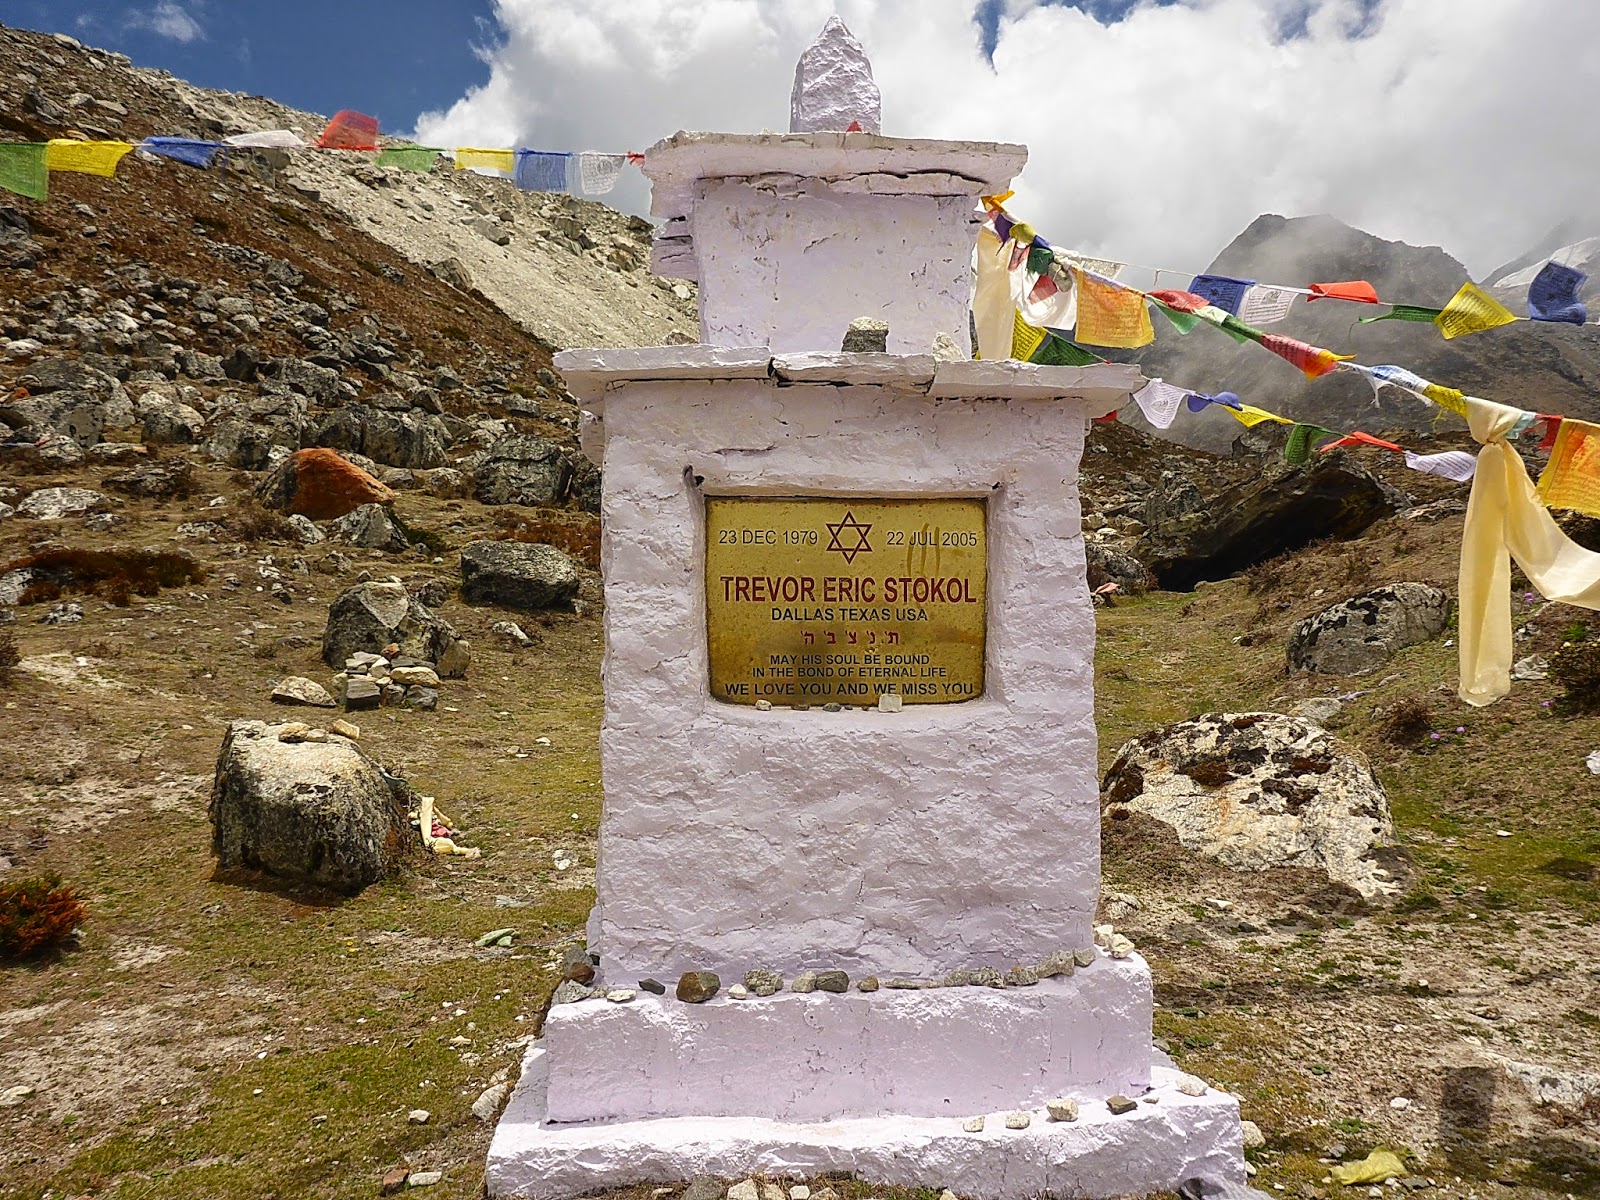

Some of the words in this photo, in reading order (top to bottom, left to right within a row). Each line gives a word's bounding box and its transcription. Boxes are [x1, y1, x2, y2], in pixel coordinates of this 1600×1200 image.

[719, 530, 737, 544] 23
[743, 530, 776, 544] DEC
[783, 530, 818, 545] 1979
[887, 531, 904, 545] 22
[909, 531, 937, 546] JUL
[942, 532, 977, 546] 2005
[720, 577, 816, 602] TREVOR
[824, 577, 876, 602] ERIC
[884, 578, 977, 603] STOKOL
[772, 608, 834, 621] DALLAS
[840, 608, 890, 621] TEXAS
[896, 608, 928, 621] USA
[770, 655, 798, 664] MAY
[802, 655, 822, 664] HIS
[826, 655, 860, 665] SOUL
[864, 655, 881, 664] BE
[885, 655, 930, 664] BOUND
[752, 668, 766, 677] IN
[769, 668, 794, 677] THE
[798, 667, 834, 677] BOND
[838, 667, 854, 677] OF
[858, 667, 916, 677] ETERNAL
[920, 667, 947, 677] LIFE
[725, 684, 749, 695] WE
[755, 683, 794, 695] LOVE
[800, 683, 832, 695] YOU
[836, 683, 868, 695] AND
[874, 683, 896, 694] WE
[902, 683, 937, 694] MISS
[942, 683, 973, 694] YOU
